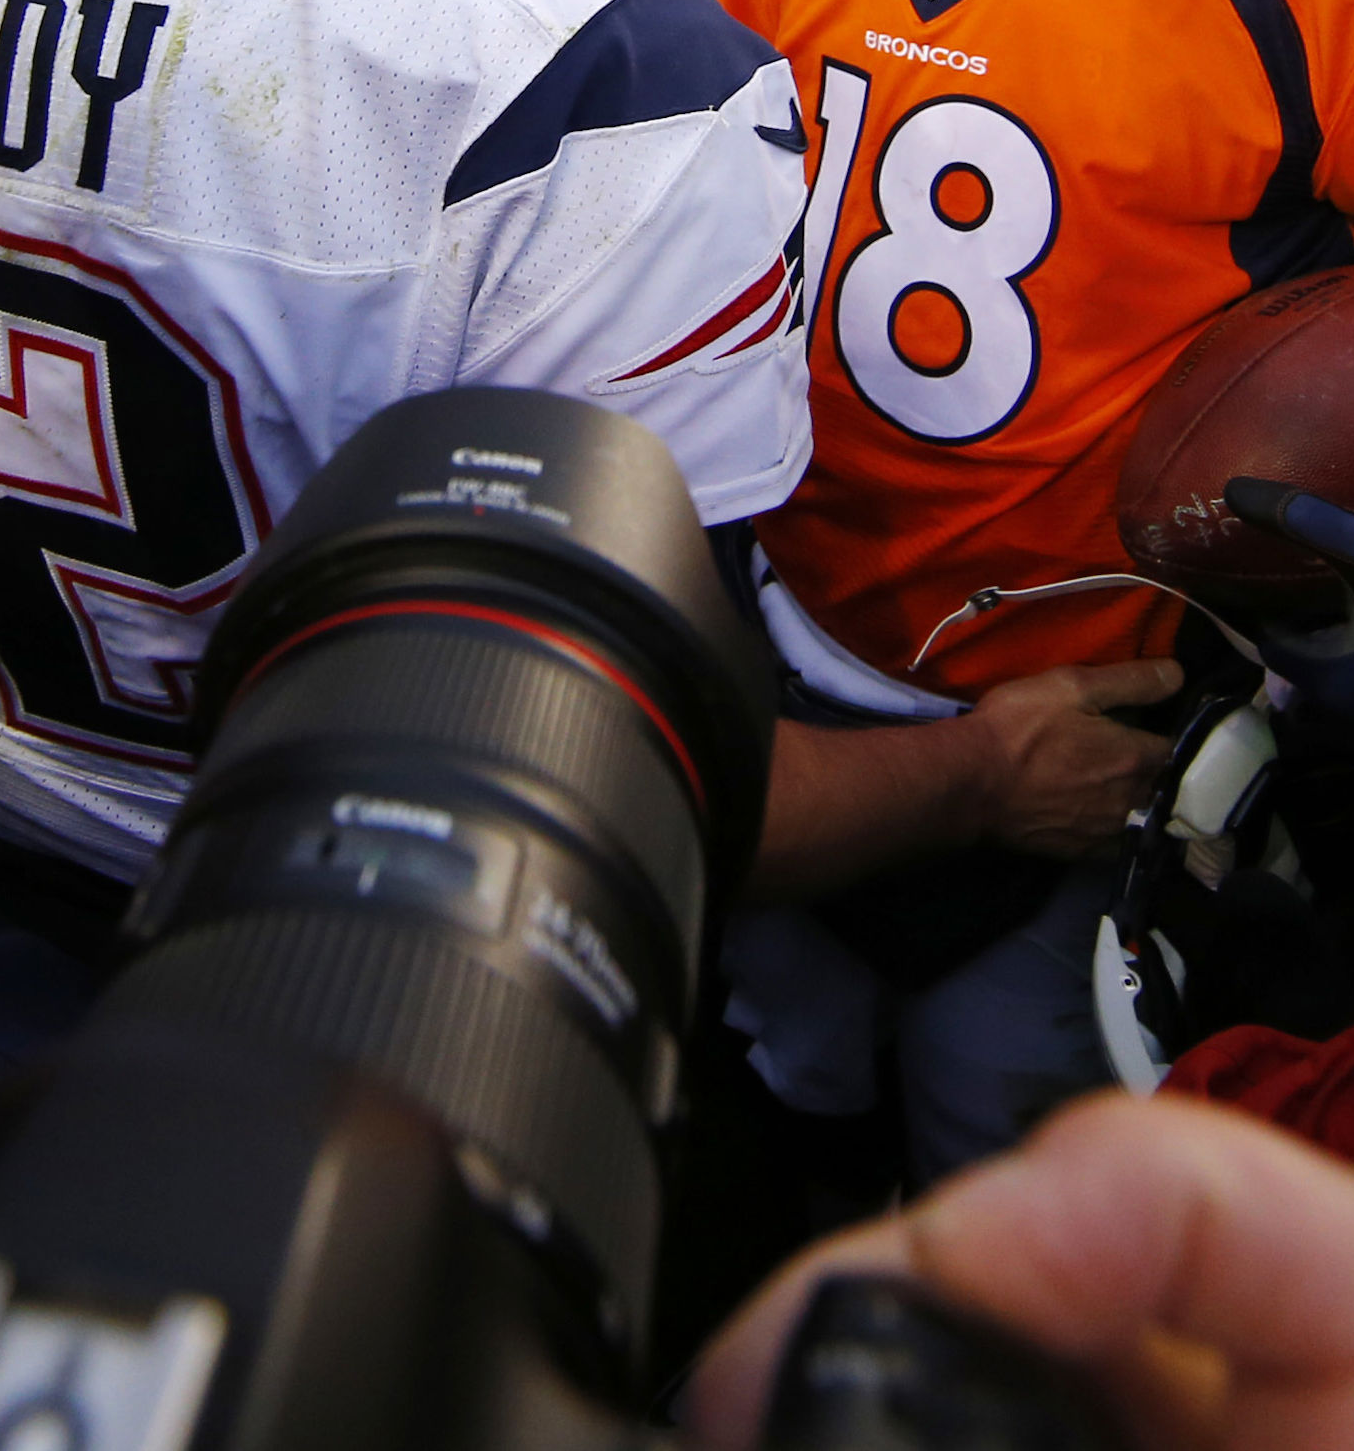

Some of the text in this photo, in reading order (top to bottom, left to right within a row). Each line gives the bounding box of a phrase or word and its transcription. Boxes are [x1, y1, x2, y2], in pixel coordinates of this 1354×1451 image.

[864, 29, 989, 76] BRONCOS
[804, 55, 1060, 446] 18
[450, 446, 544, 477] Canon
